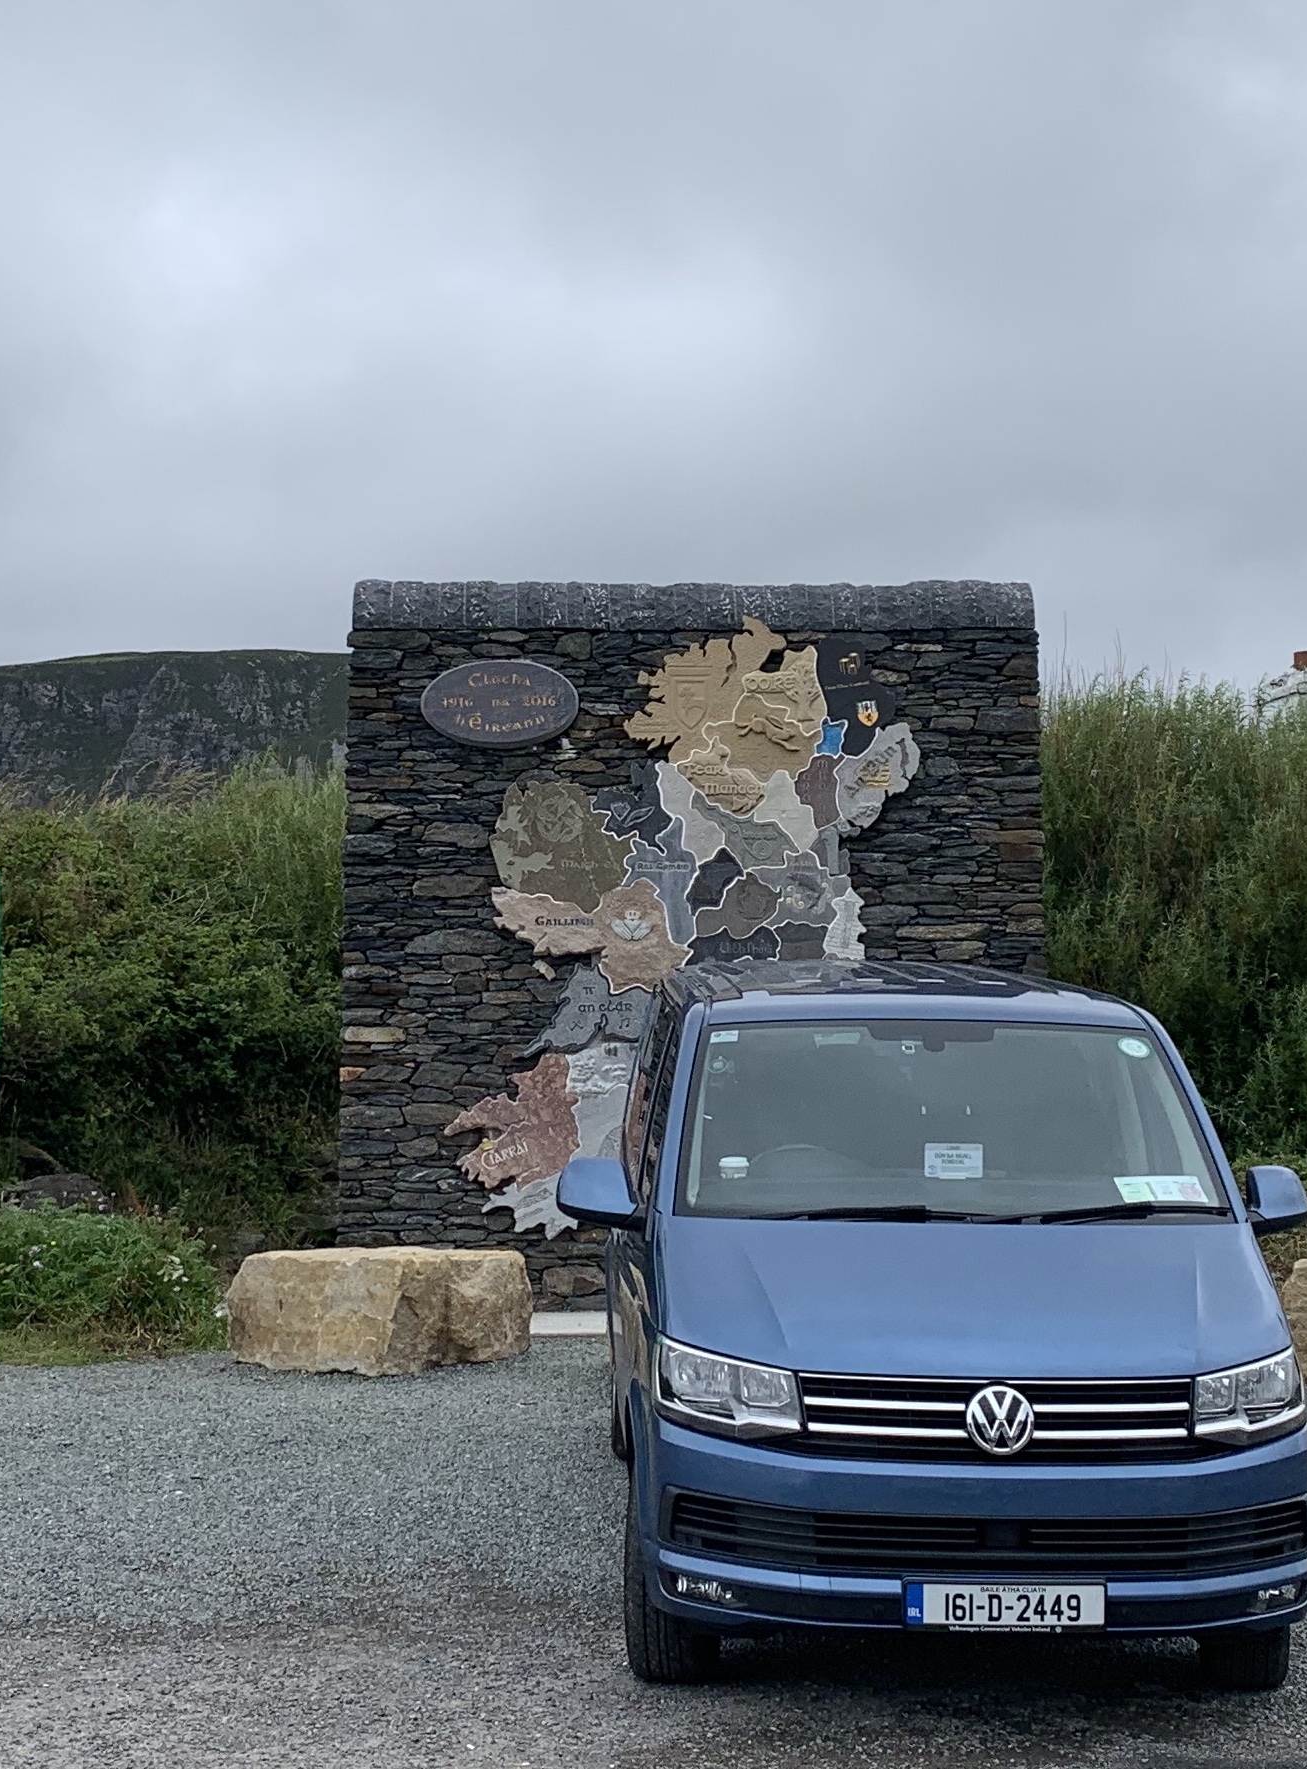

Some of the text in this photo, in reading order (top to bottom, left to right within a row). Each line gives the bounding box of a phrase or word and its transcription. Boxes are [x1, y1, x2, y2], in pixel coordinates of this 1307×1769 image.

[522, 695, 556, 707] 2016
[907, 1607, 921, 1617] IRL
[945, 1593, 1081, 1622] 161-D-2449
